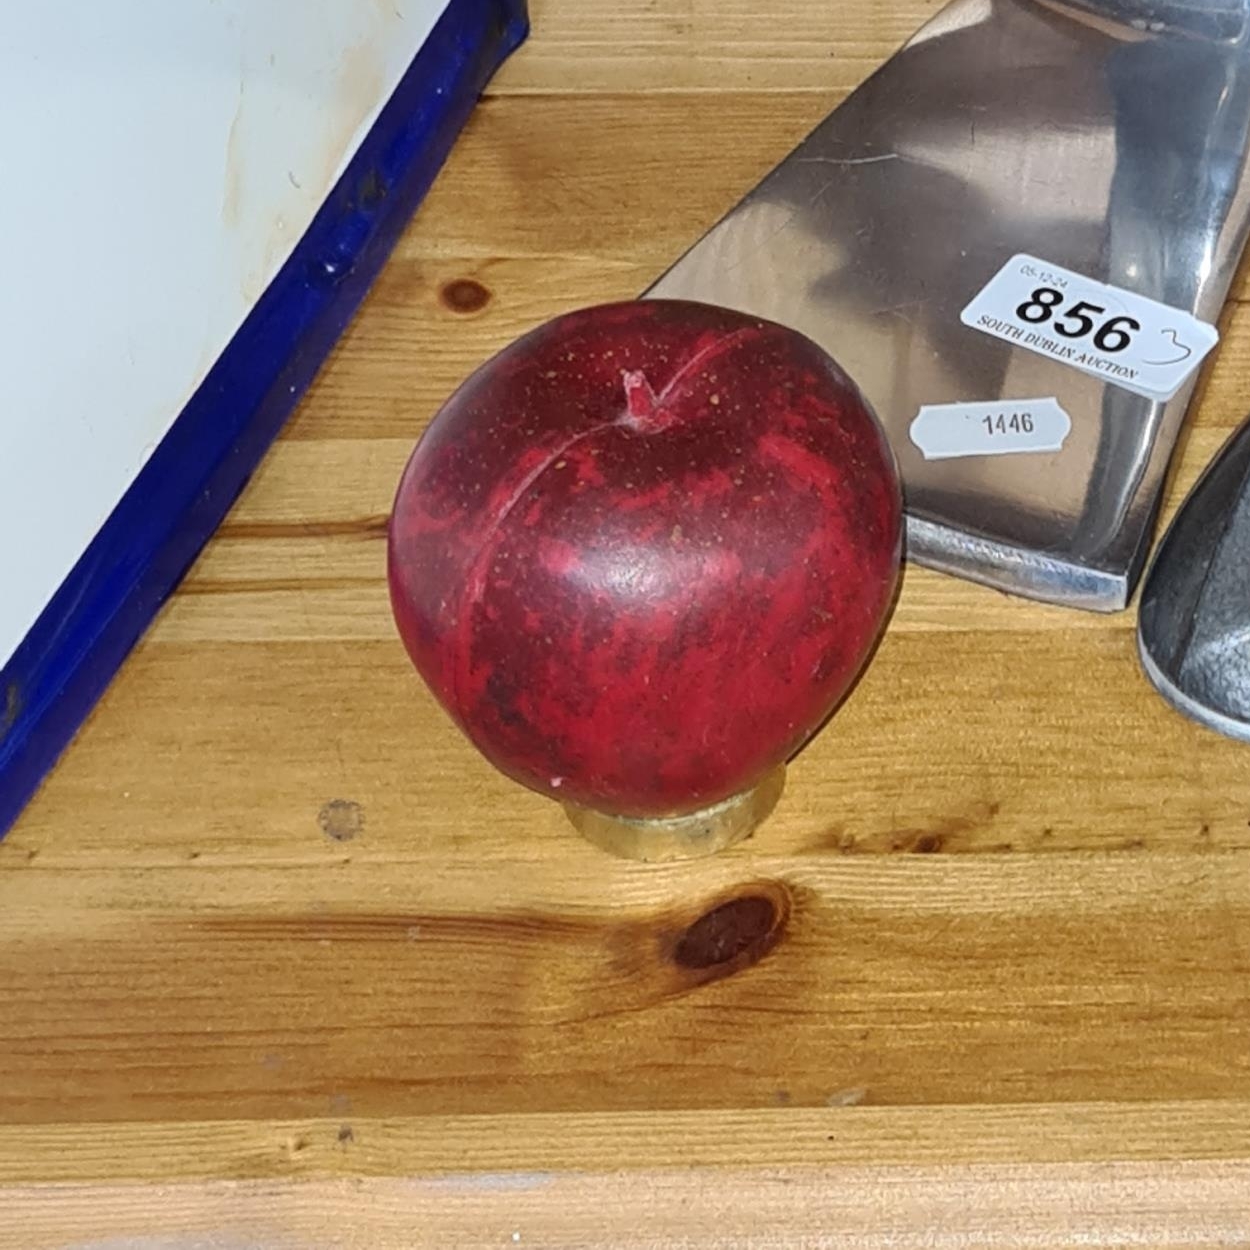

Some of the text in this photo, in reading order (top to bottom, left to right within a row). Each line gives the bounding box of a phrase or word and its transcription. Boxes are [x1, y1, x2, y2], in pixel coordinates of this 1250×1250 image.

[977, 315, 1139, 379] SOUTH DUBLIN AUCTION
[1015, 287, 1141, 353] 856
[981, 412, 1034, 435] 1446
